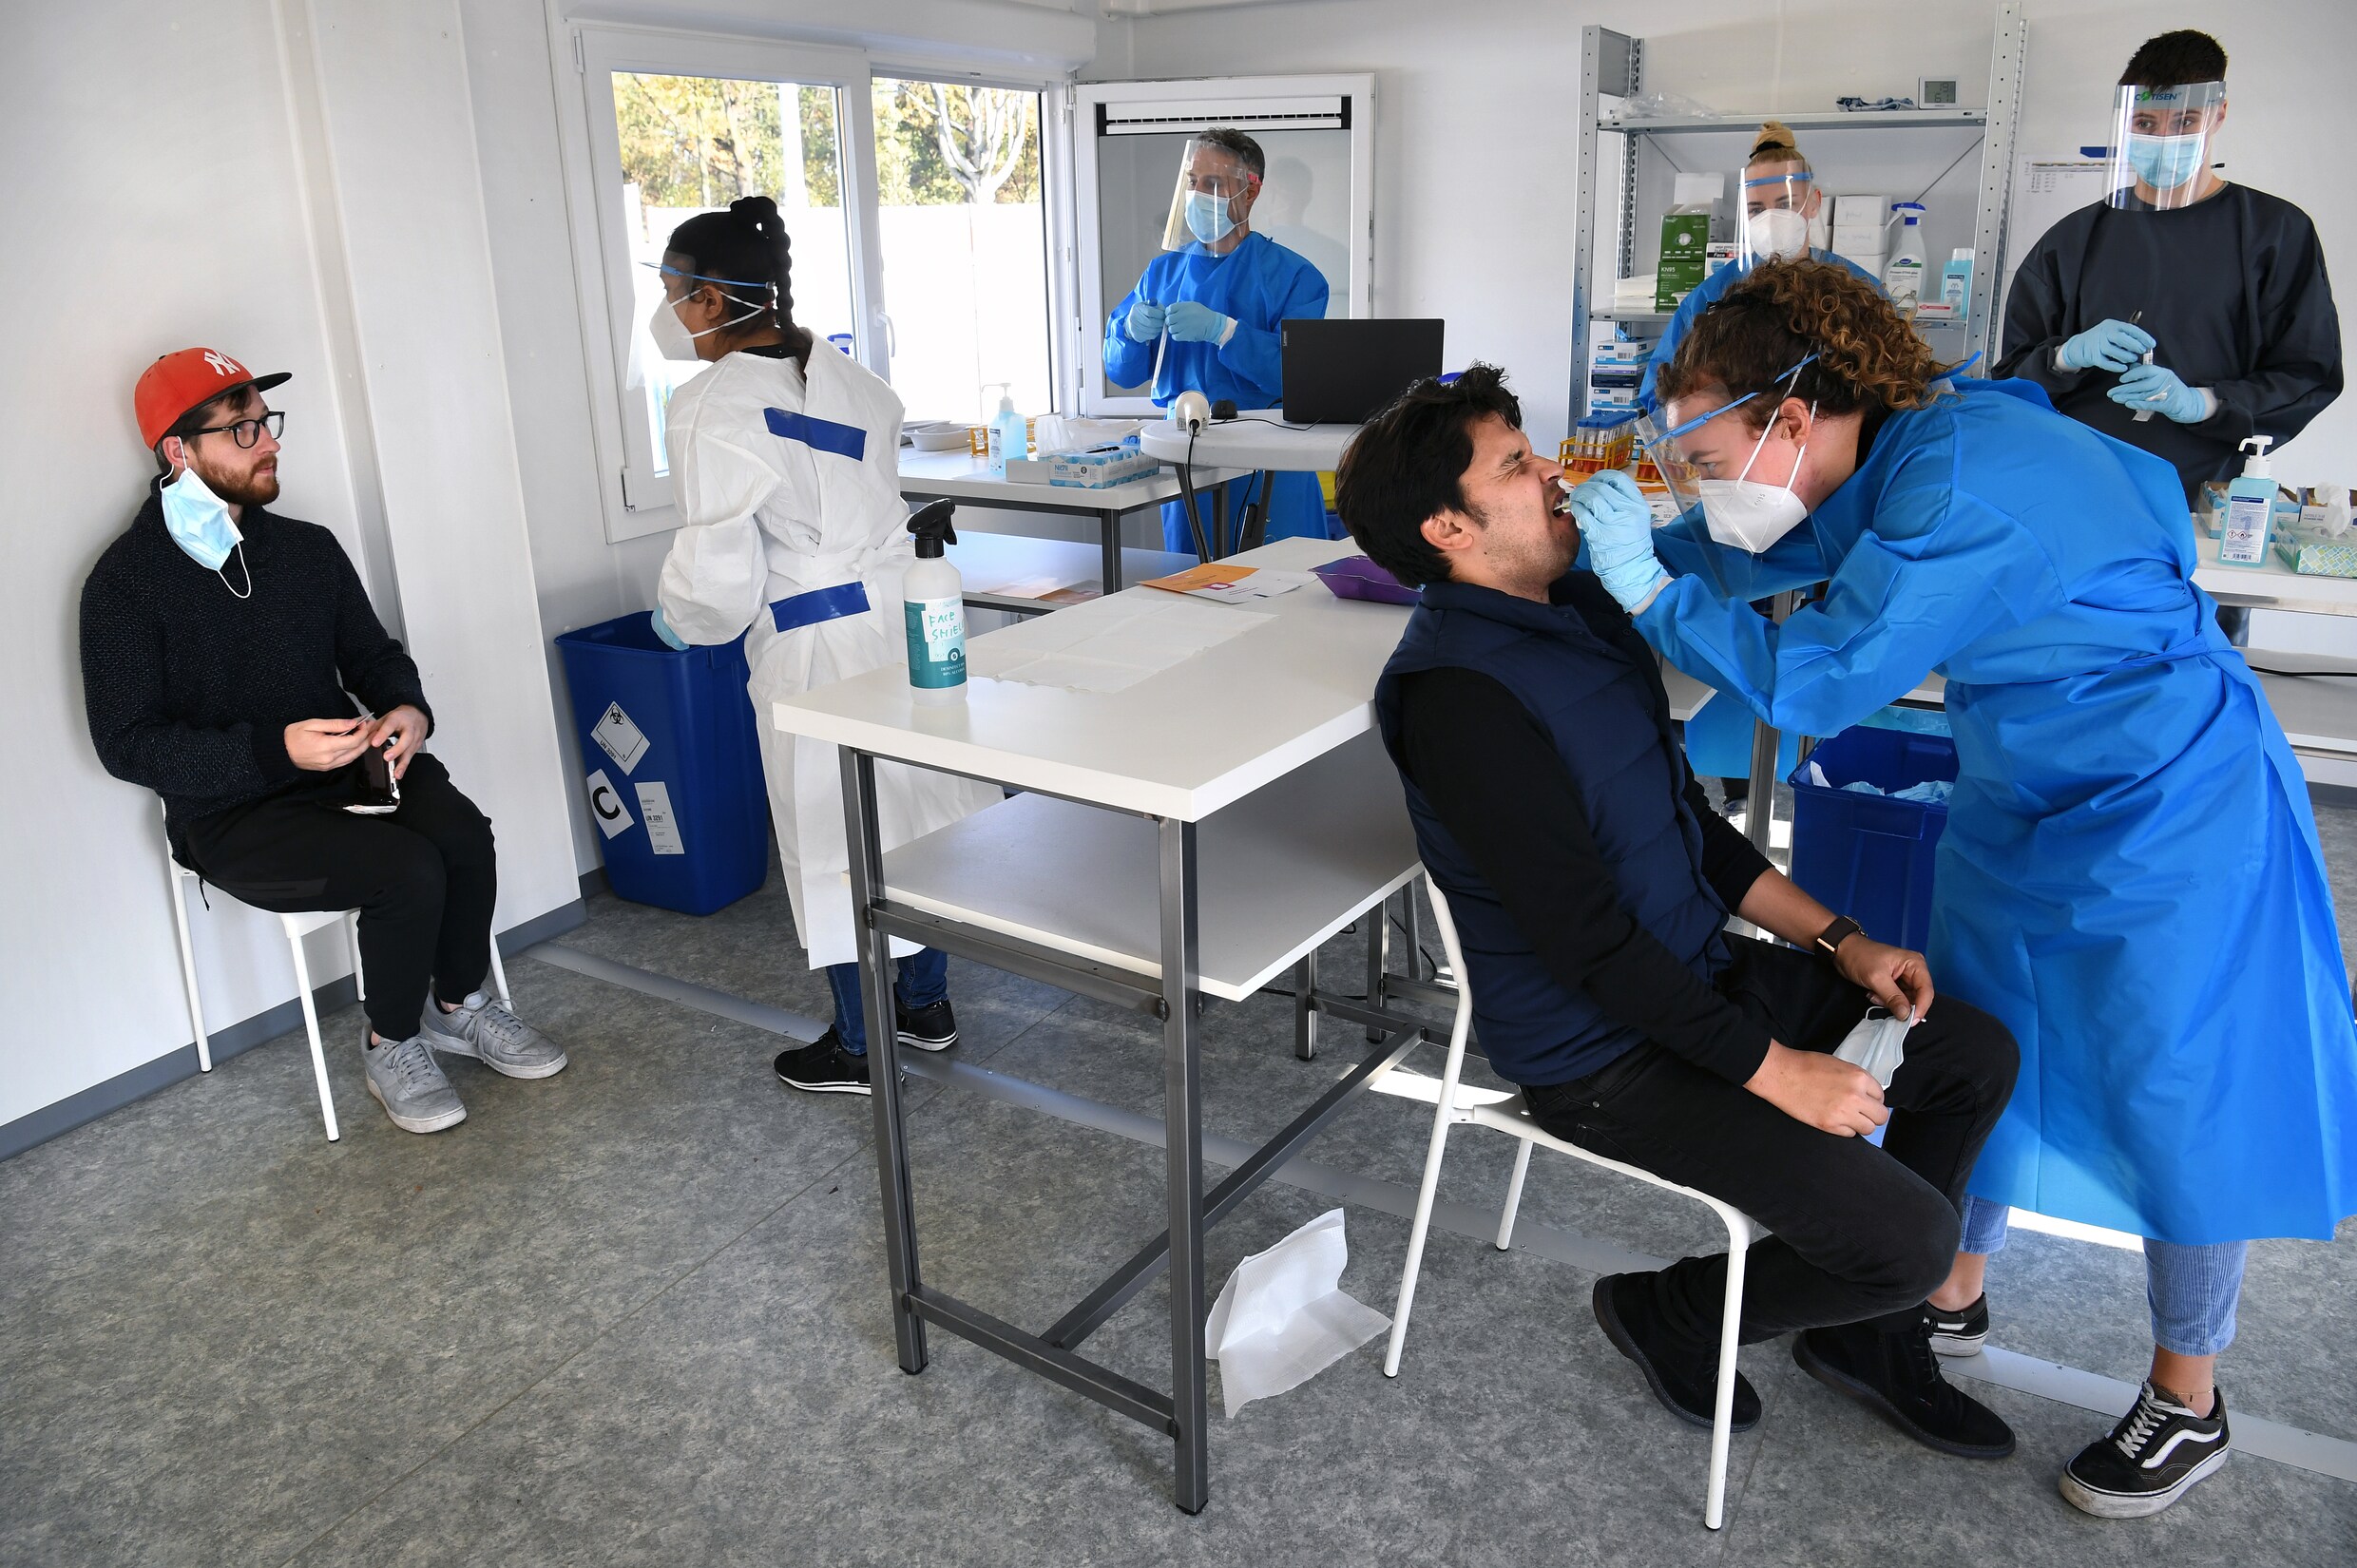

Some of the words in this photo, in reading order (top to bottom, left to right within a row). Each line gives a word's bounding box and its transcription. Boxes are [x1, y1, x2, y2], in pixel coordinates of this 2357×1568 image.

[600, 740, 607, 749] UN
[606, 748, 617, 759] 3291
[592, 786, 621, 820] C
